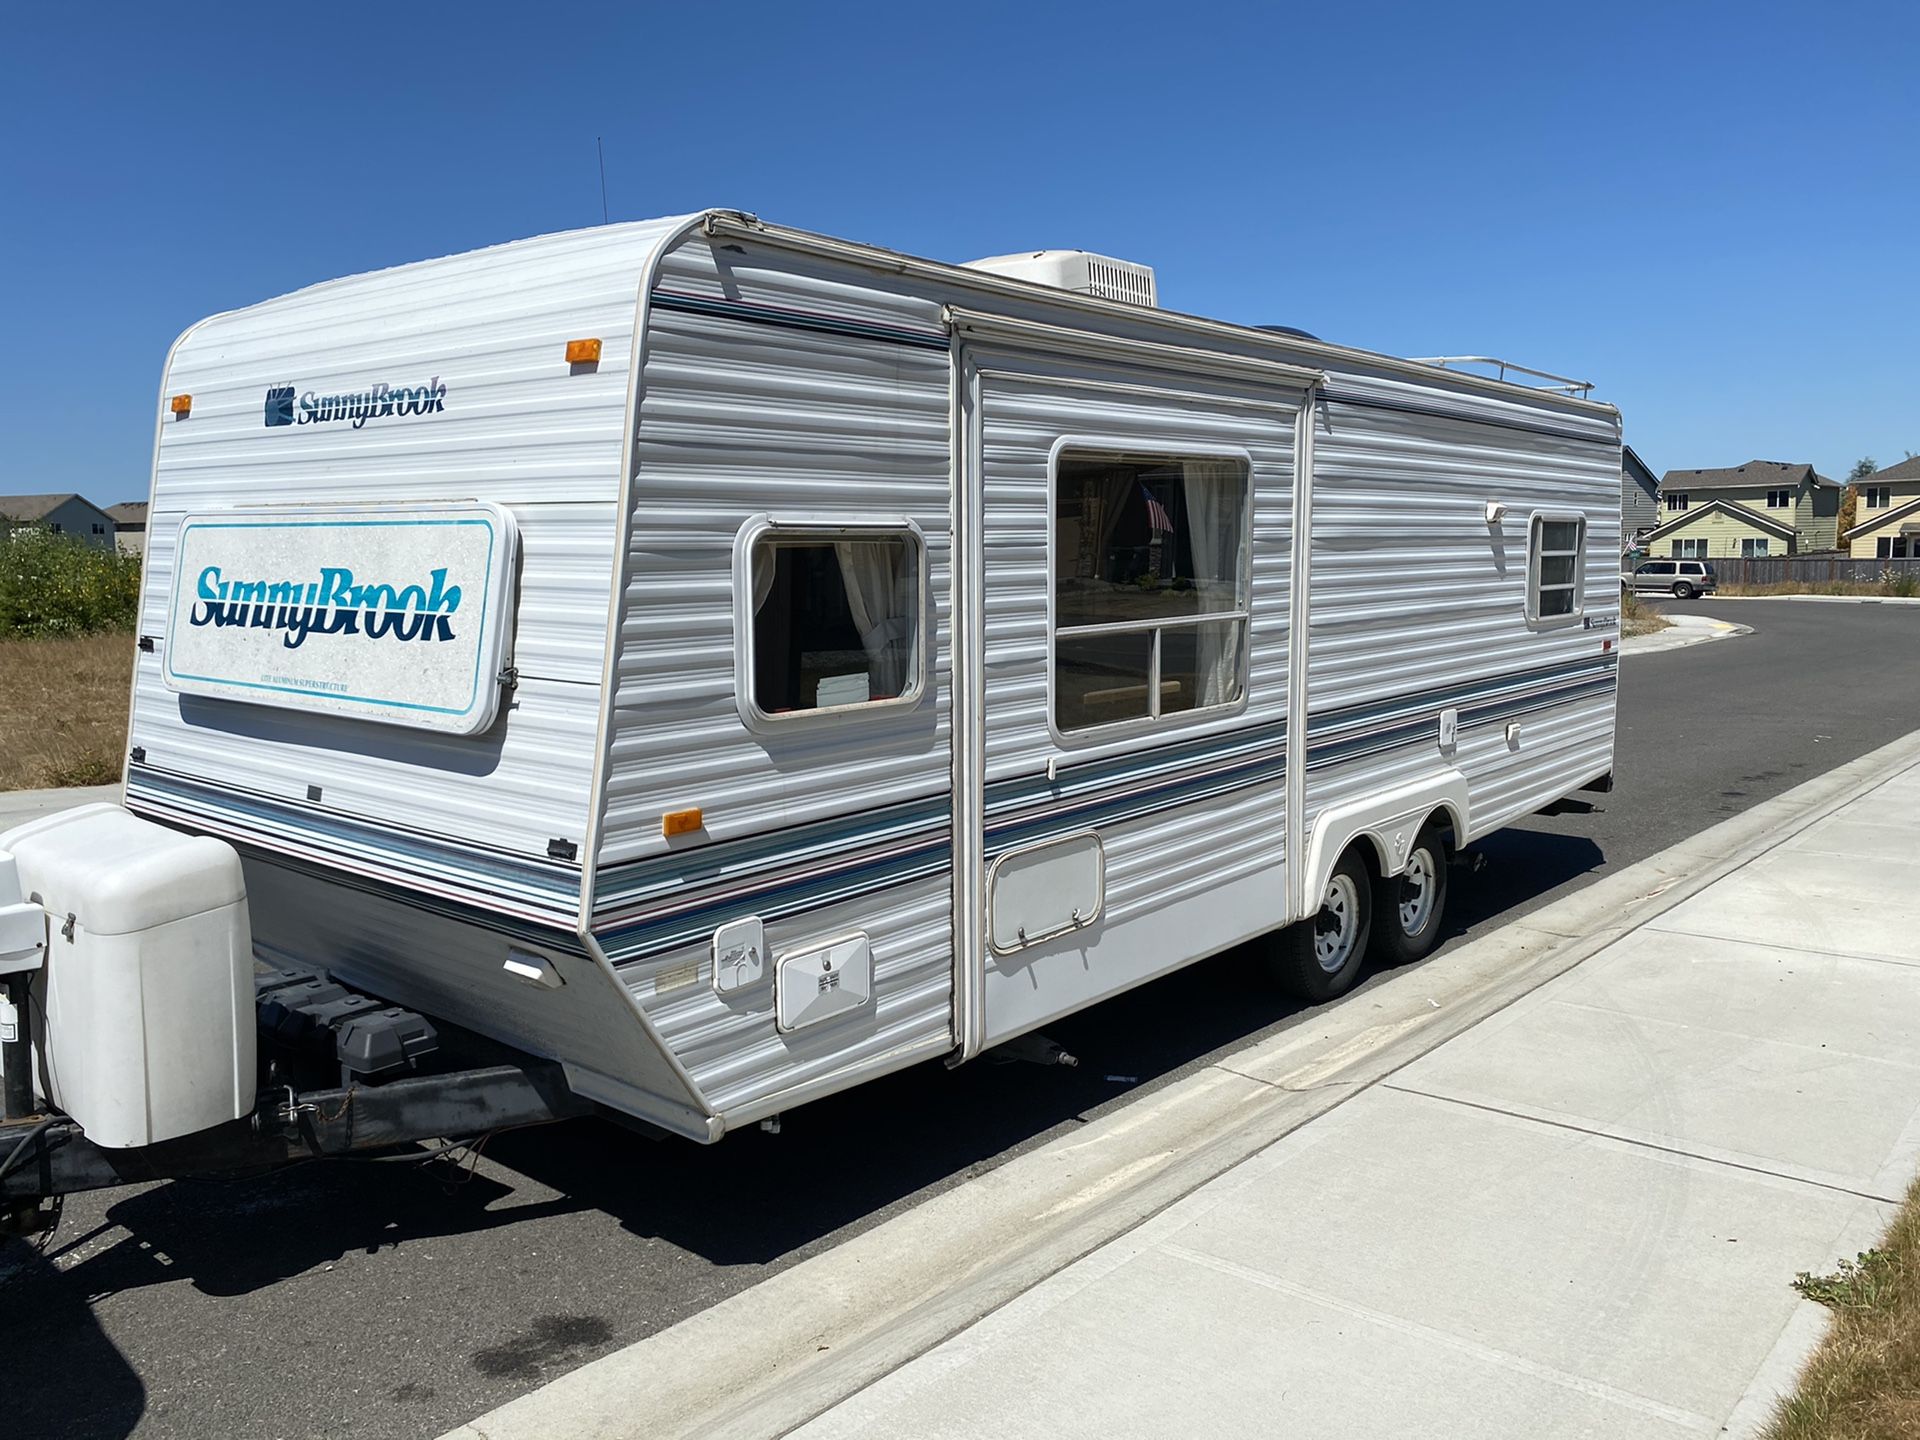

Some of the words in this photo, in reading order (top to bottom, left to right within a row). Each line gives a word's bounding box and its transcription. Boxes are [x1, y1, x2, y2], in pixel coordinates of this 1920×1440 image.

[298, 377, 447, 430] SunnyBrook
[190, 566, 462, 648] SunnyBrook
[299, 679, 348, 692] SUPERSTRUCTURE
